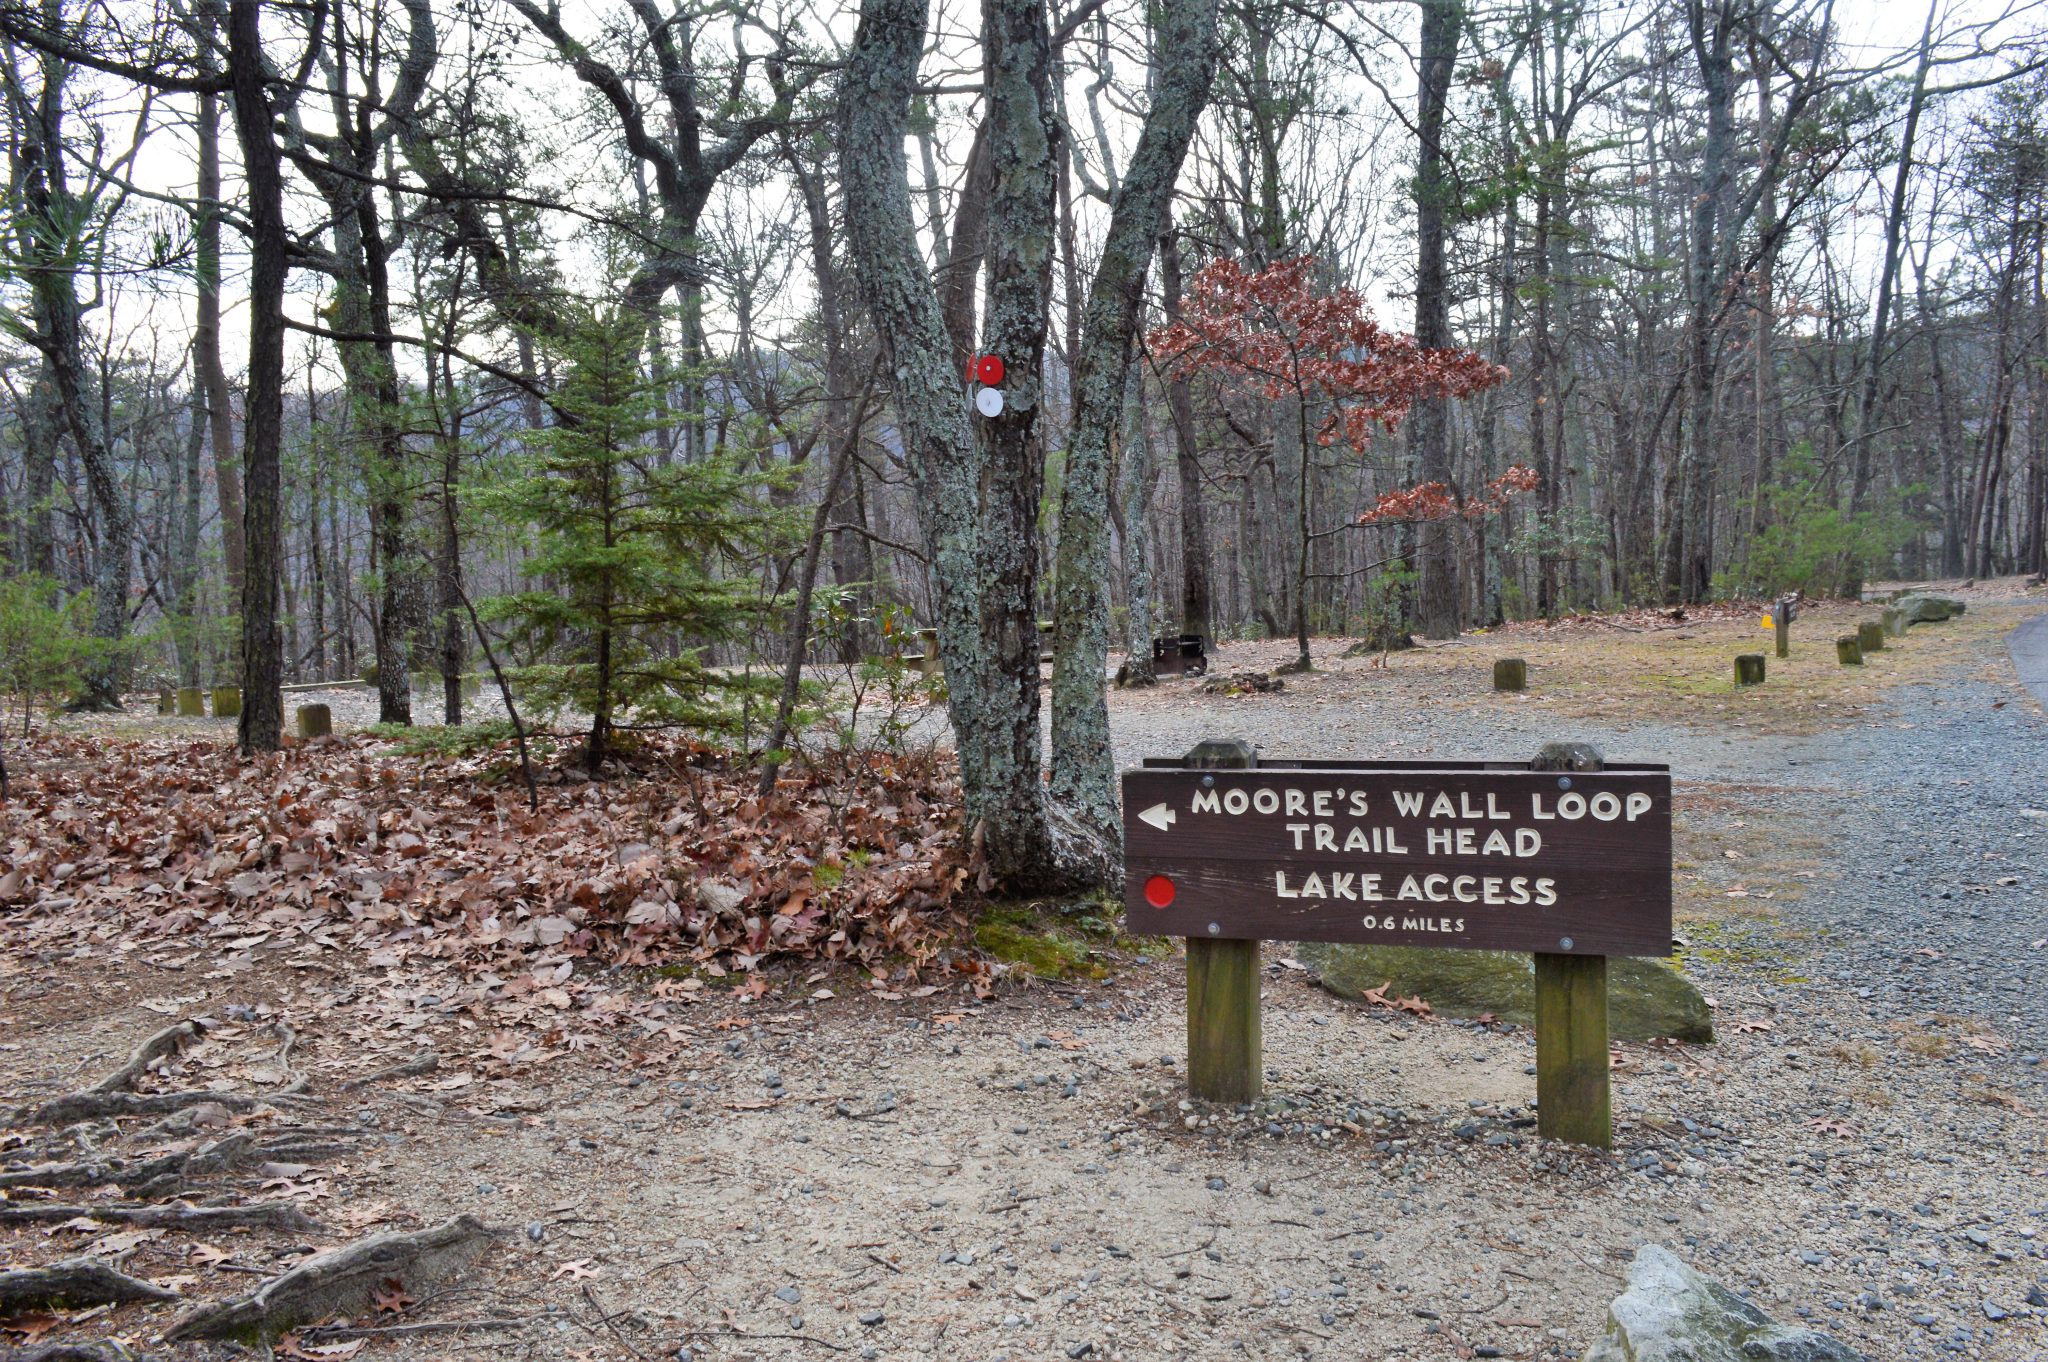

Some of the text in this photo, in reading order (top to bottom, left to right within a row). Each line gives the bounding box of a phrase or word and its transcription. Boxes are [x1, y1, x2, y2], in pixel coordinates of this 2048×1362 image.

[1191, 788, 1652, 822] MOORE'S WALL LOOP
[1285, 823, 1542, 858] TRAIL HEAD
[1275, 870, 1557, 906] LAKE ACCESS
[1363, 915, 1465, 933] 0.6 MILES
